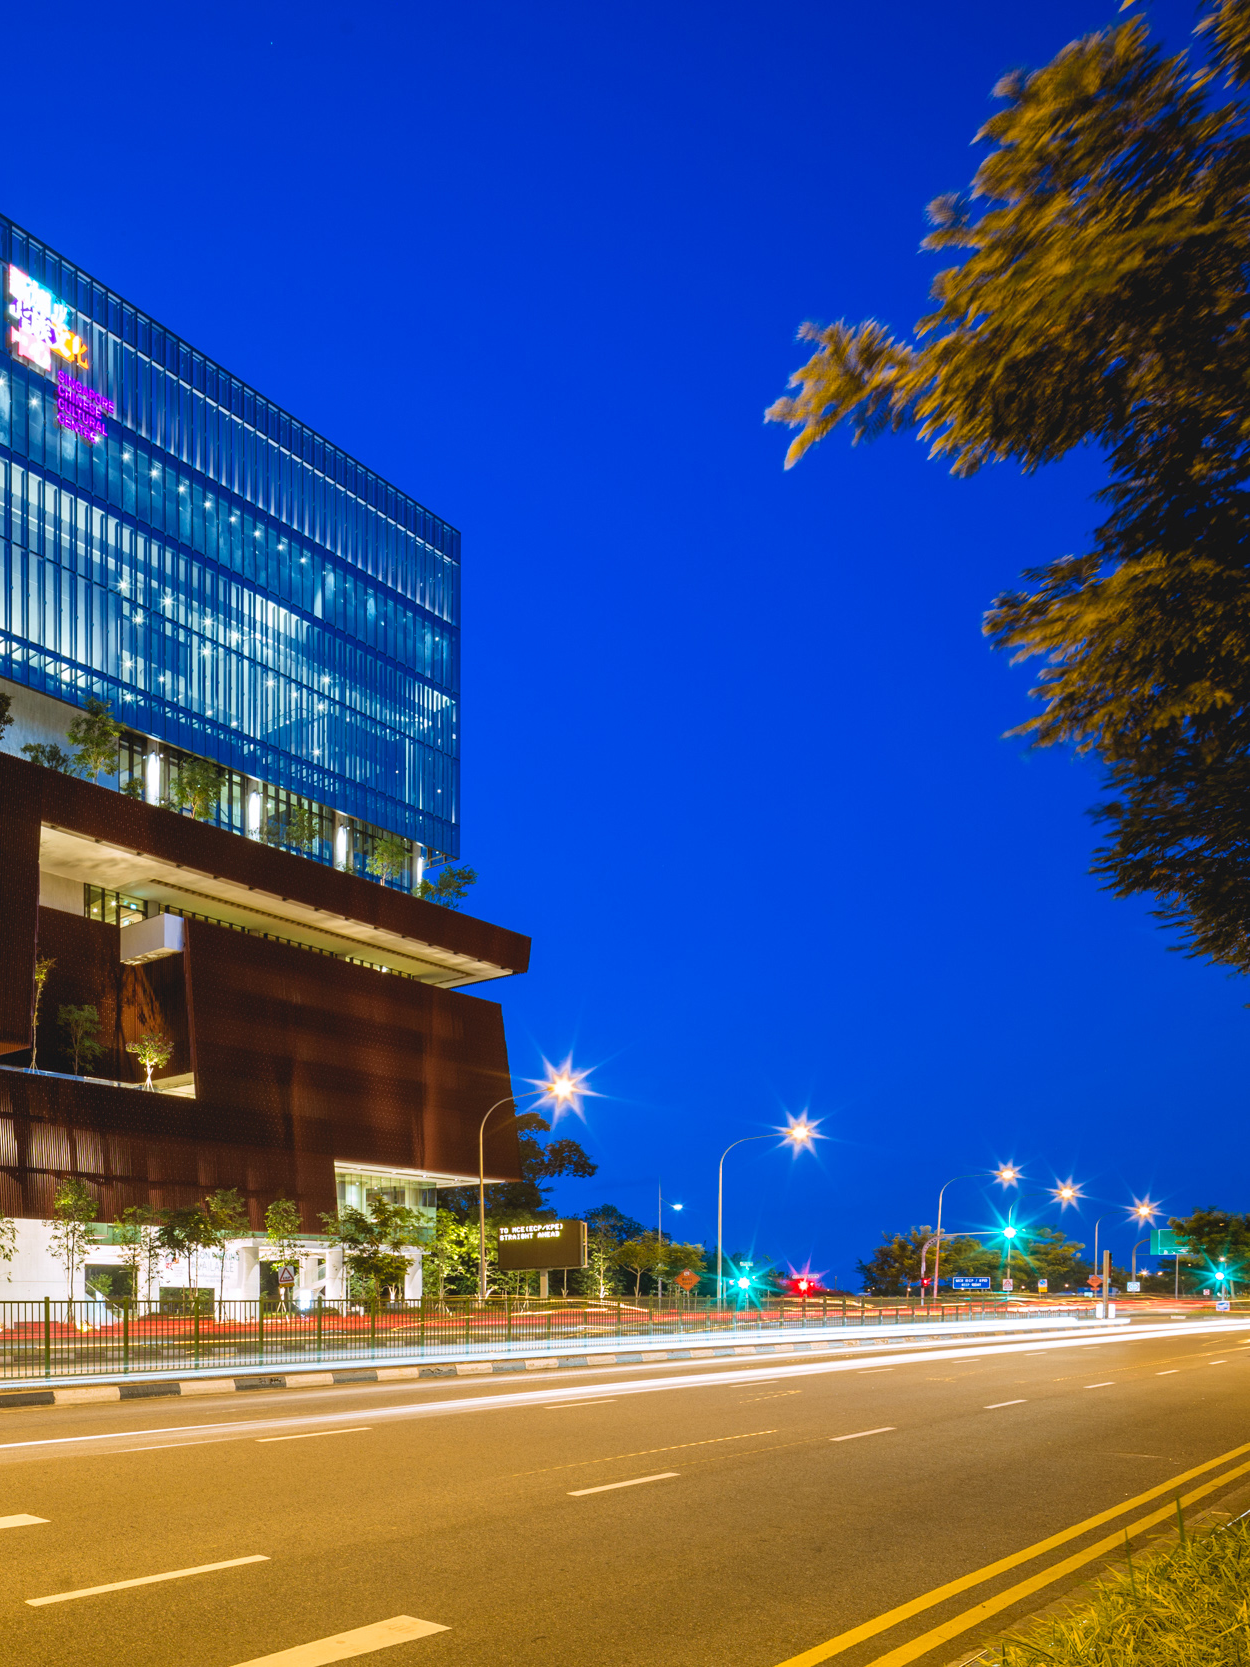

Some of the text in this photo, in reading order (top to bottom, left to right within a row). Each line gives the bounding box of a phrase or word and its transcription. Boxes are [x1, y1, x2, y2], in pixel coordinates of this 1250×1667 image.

[58, 370, 114, 414] SINGAPORE
[58, 384, 102, 419] CHINESE
[57, 398, 108, 437] CULTURAL
[57, 412, 99, 444] CENTRE
[500, 1230, 560, 1241] STRAIGHT AHEAD
